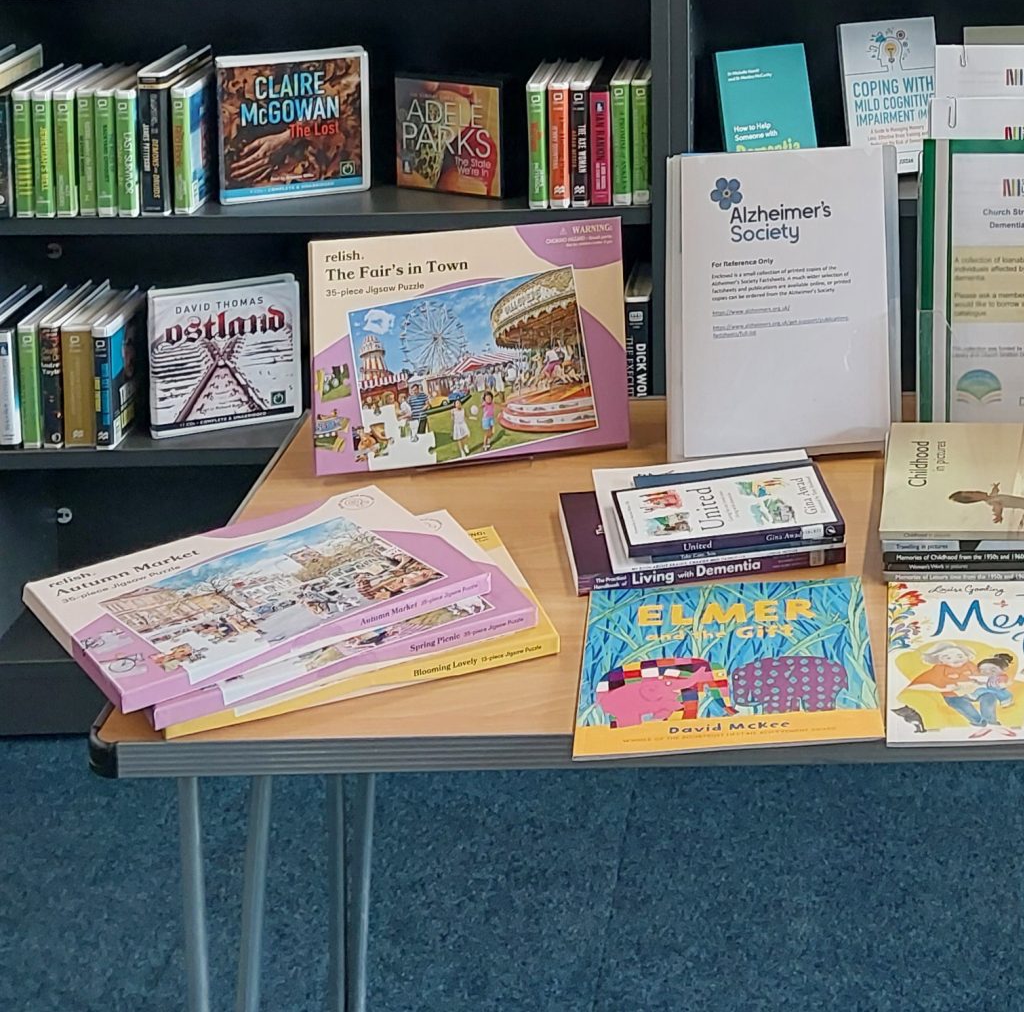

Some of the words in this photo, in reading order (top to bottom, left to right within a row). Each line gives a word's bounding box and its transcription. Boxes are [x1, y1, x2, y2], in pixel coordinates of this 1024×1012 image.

[255, 71, 325, 99] CLAIRE
[853, 79, 898, 98] COPING
[902, 76, 934, 92] WITH
[240, 96, 340, 127] McGOWAN
[406, 98, 483, 128] ADELE
[854, 99, 880, 113] MILD
[290, 124, 311, 138] The
[313, 121, 339, 136] Lost
[856, 110, 915, 127] IMPAIRMENT
[402, 122, 491, 159] PARKS
[730, 201, 832, 224] Alzheimer's
[730, 223, 800, 244] Society
[325, 250, 365, 263] relish.
[325, 268, 355, 282] The
[358, 264, 404, 279] Fair's
[408, 263, 422, 275] in
[425, 259, 468, 273] Town
[175, 302, 210, 314] DAVID
[216, 296, 264, 308] THOMAS
[908, 440, 930, 487] Childhood
[683, 540, 713, 551] United
[56, 570, 130, 596] Autumn
[133, 550, 200, 572] Market
[631, 568, 674, 585] Living
[677, 570, 695, 579] with
[695, 559, 762, 578] Dementia
[637, 598, 816, 626] ELMER
[410, 639, 436, 652] Spring
[437, 633, 460, 646] Picnic
[413, 663, 451, 677] Blooming
[452, 658, 478, 670] Lovely
[669, 723, 721, 734] David
[729, 720, 790, 731] McKee
